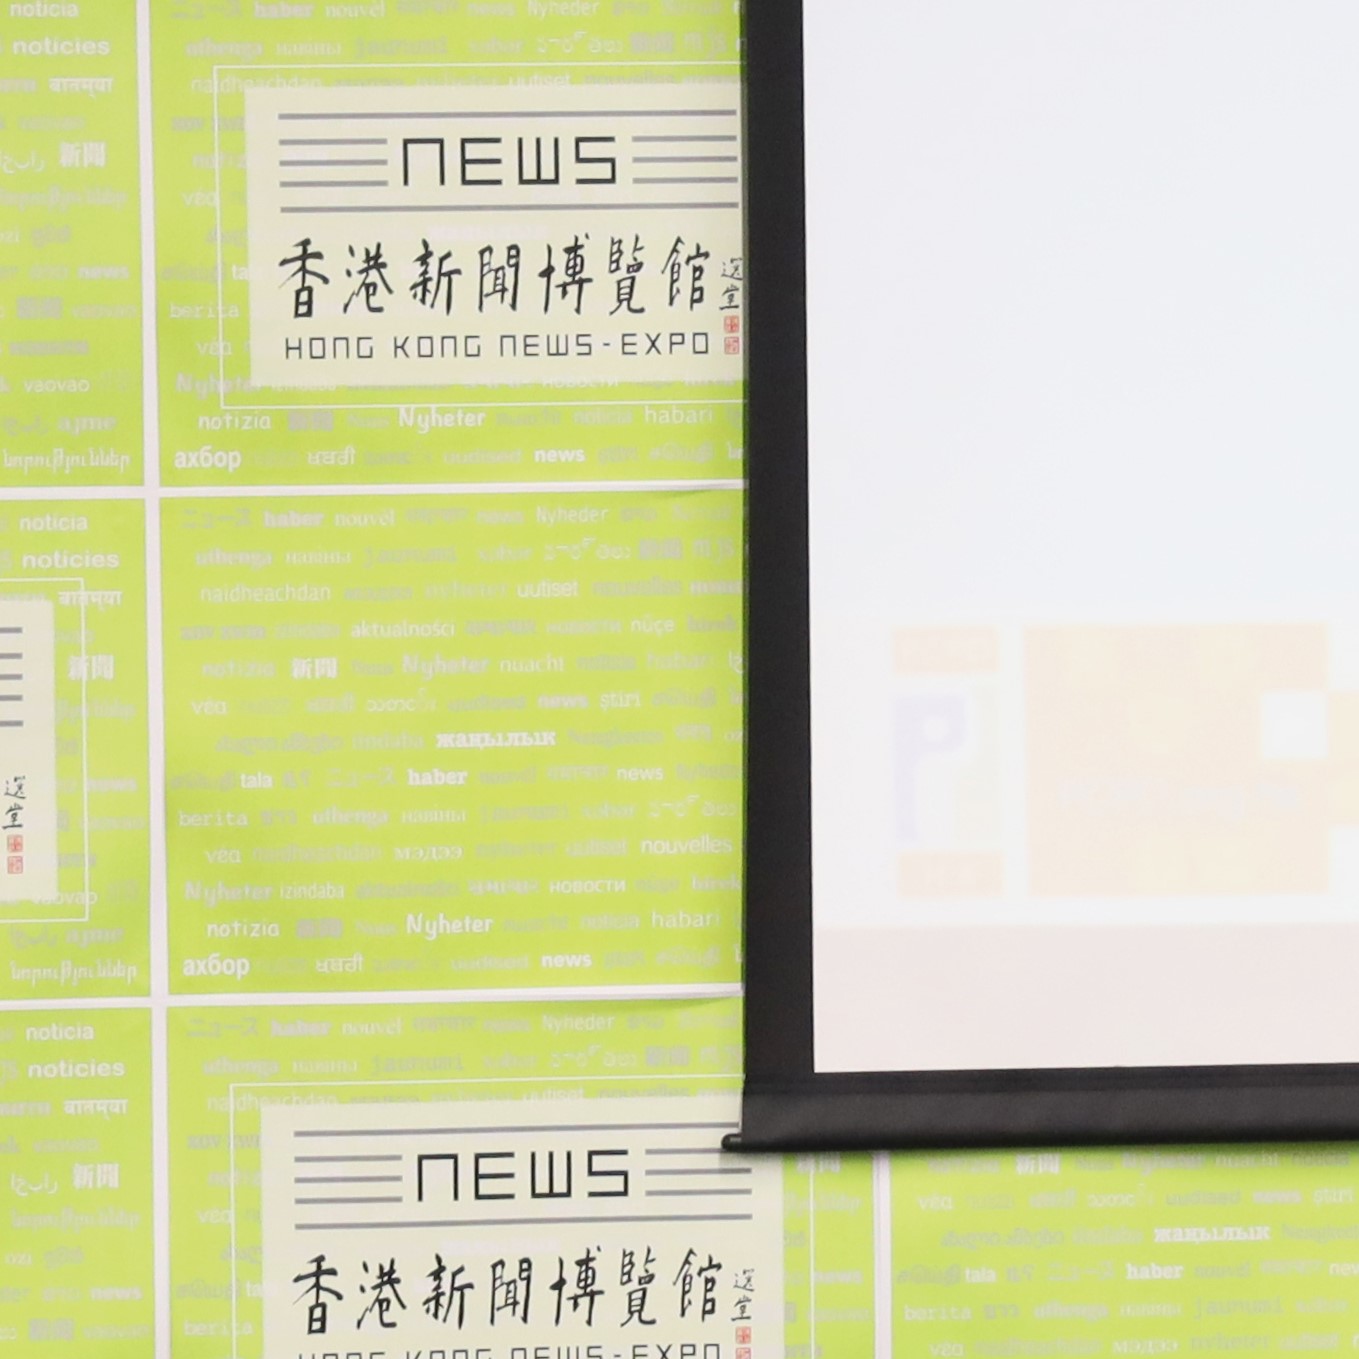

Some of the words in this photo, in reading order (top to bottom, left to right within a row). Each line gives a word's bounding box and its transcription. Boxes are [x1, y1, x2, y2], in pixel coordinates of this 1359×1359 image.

[285, 336, 373, 360] HONG
[394, 335, 481, 358] KONG
[399, 405, 486, 431] Nyheter
[534, 449, 586, 463] news
[407, 768, 468, 786] haber
[406, 913, 494, 941] Nyheter
[541, 954, 593, 968] news
